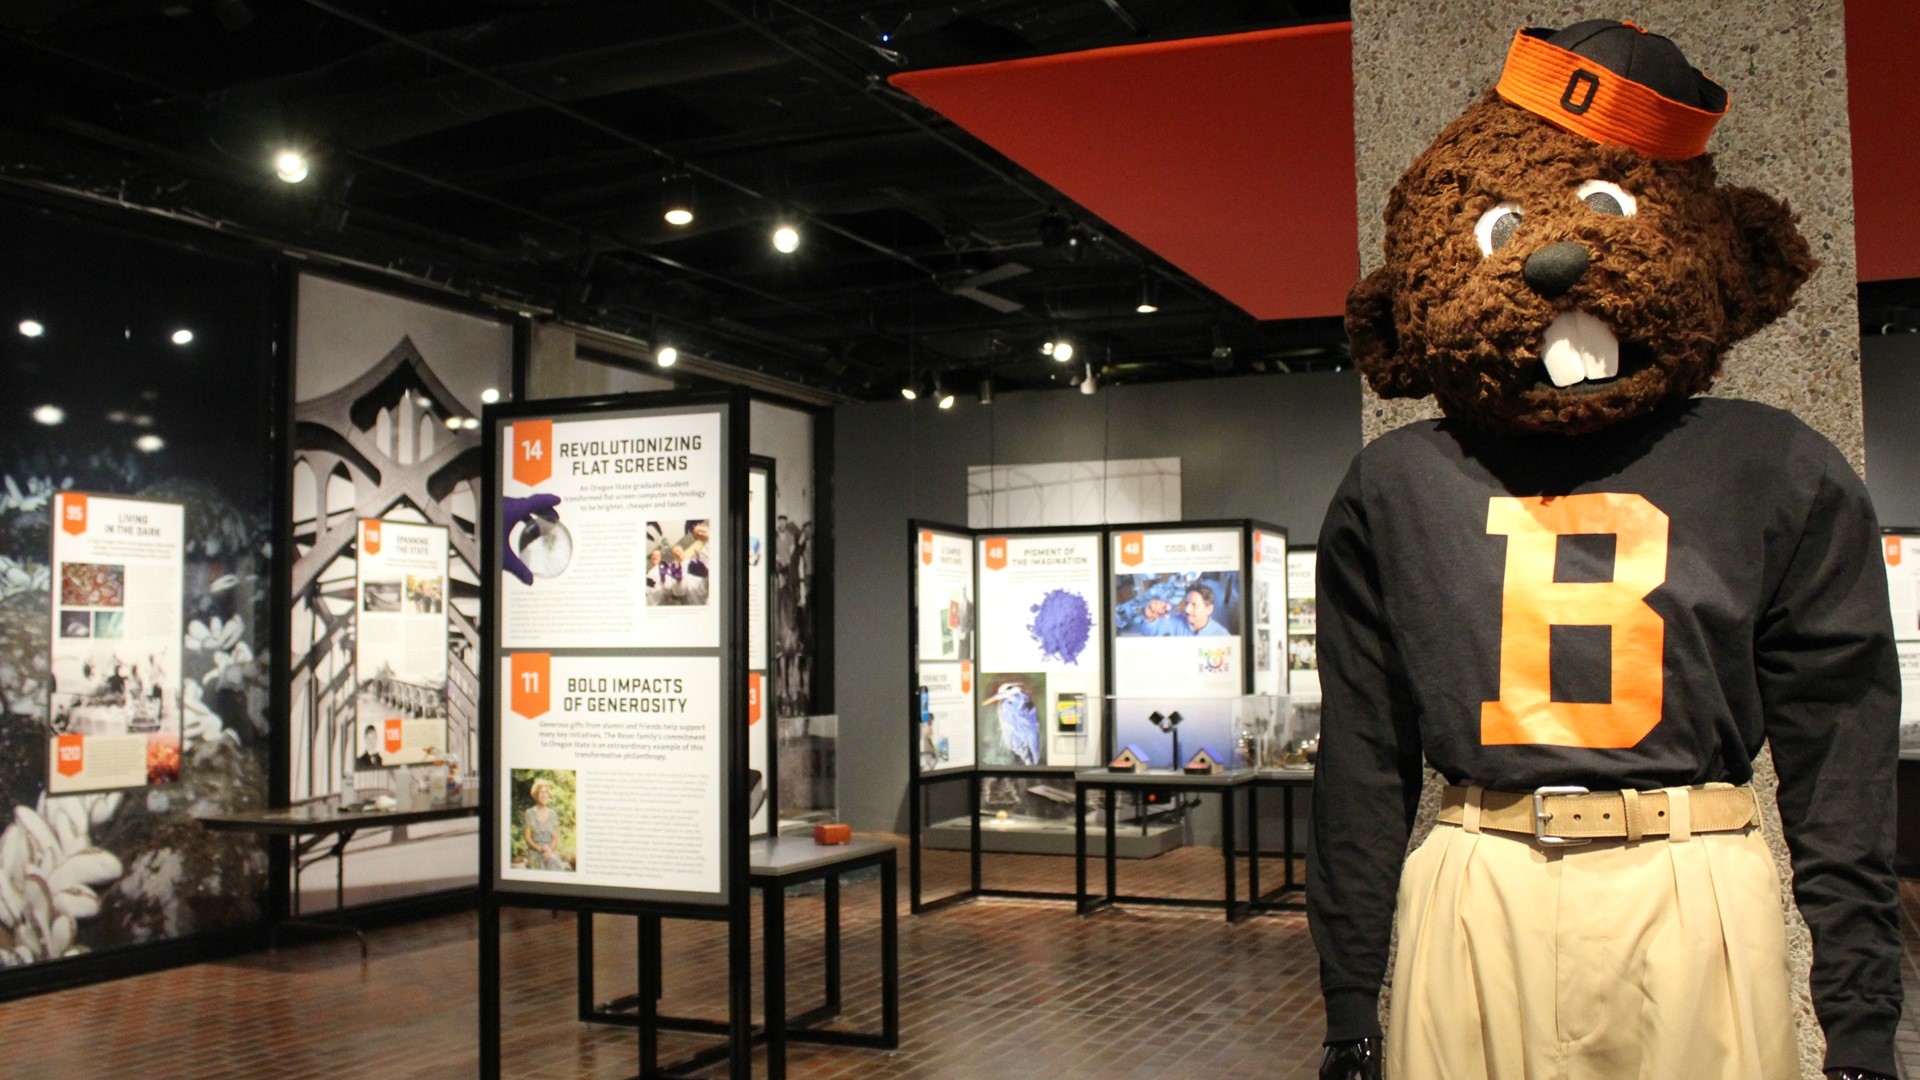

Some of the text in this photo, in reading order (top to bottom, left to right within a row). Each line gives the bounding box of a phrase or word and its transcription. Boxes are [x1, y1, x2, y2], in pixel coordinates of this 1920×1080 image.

[521, 439, 543, 461] 14
[560, 435, 702, 458] REVOLUTIONIZING
[572, 456, 688, 476] FLAT SCREENS
[590, 485, 614, 493] Oregon
[615, 483, 631, 491] State
[633, 482, 662, 491] graduate
[663, 480, 690, 489] student
[564, 494, 602, 503] transformed
[615, 493, 636, 501] screen
[636, 491, 668, 501] computer
[669, 489, 706, 499] technology
[588, 503, 596, 511] be
[626, 502, 652, 511] cheaper
[654, 501, 666, 509] and
[118, 513, 149, 524] LIVING
[105, 524, 161, 537] IN THE DARK
[396, 535, 429, 545] SPANNING
[396, 545, 429, 555] THE STATE
[1024, 547, 1075, 557] PIGMENT OF
[1165, 543, 1214, 554] COOL BLUE
[1012, 557, 1088, 567] THE IMAGINATION
[1481, 492, 1669, 749] B
[521, 672, 540, 694] 11
[568, 677, 683, 694] BOLD IMPACTS
[564, 697, 687, 713] OF GENEROSITY
[539, 721, 706, 732] Generous gifts from alumni and friends help support
[539, 731, 555, 740] many
[556, 731, 568, 740] key
[663, 733, 706, 741] commitment
[548, 741, 573, 750] Oregon
[574, 741, 590, 749] State
[607, 742, 652, 751] extraordinary
[653, 744, 681, 752] example
[574, 751, 622, 759] transformative
